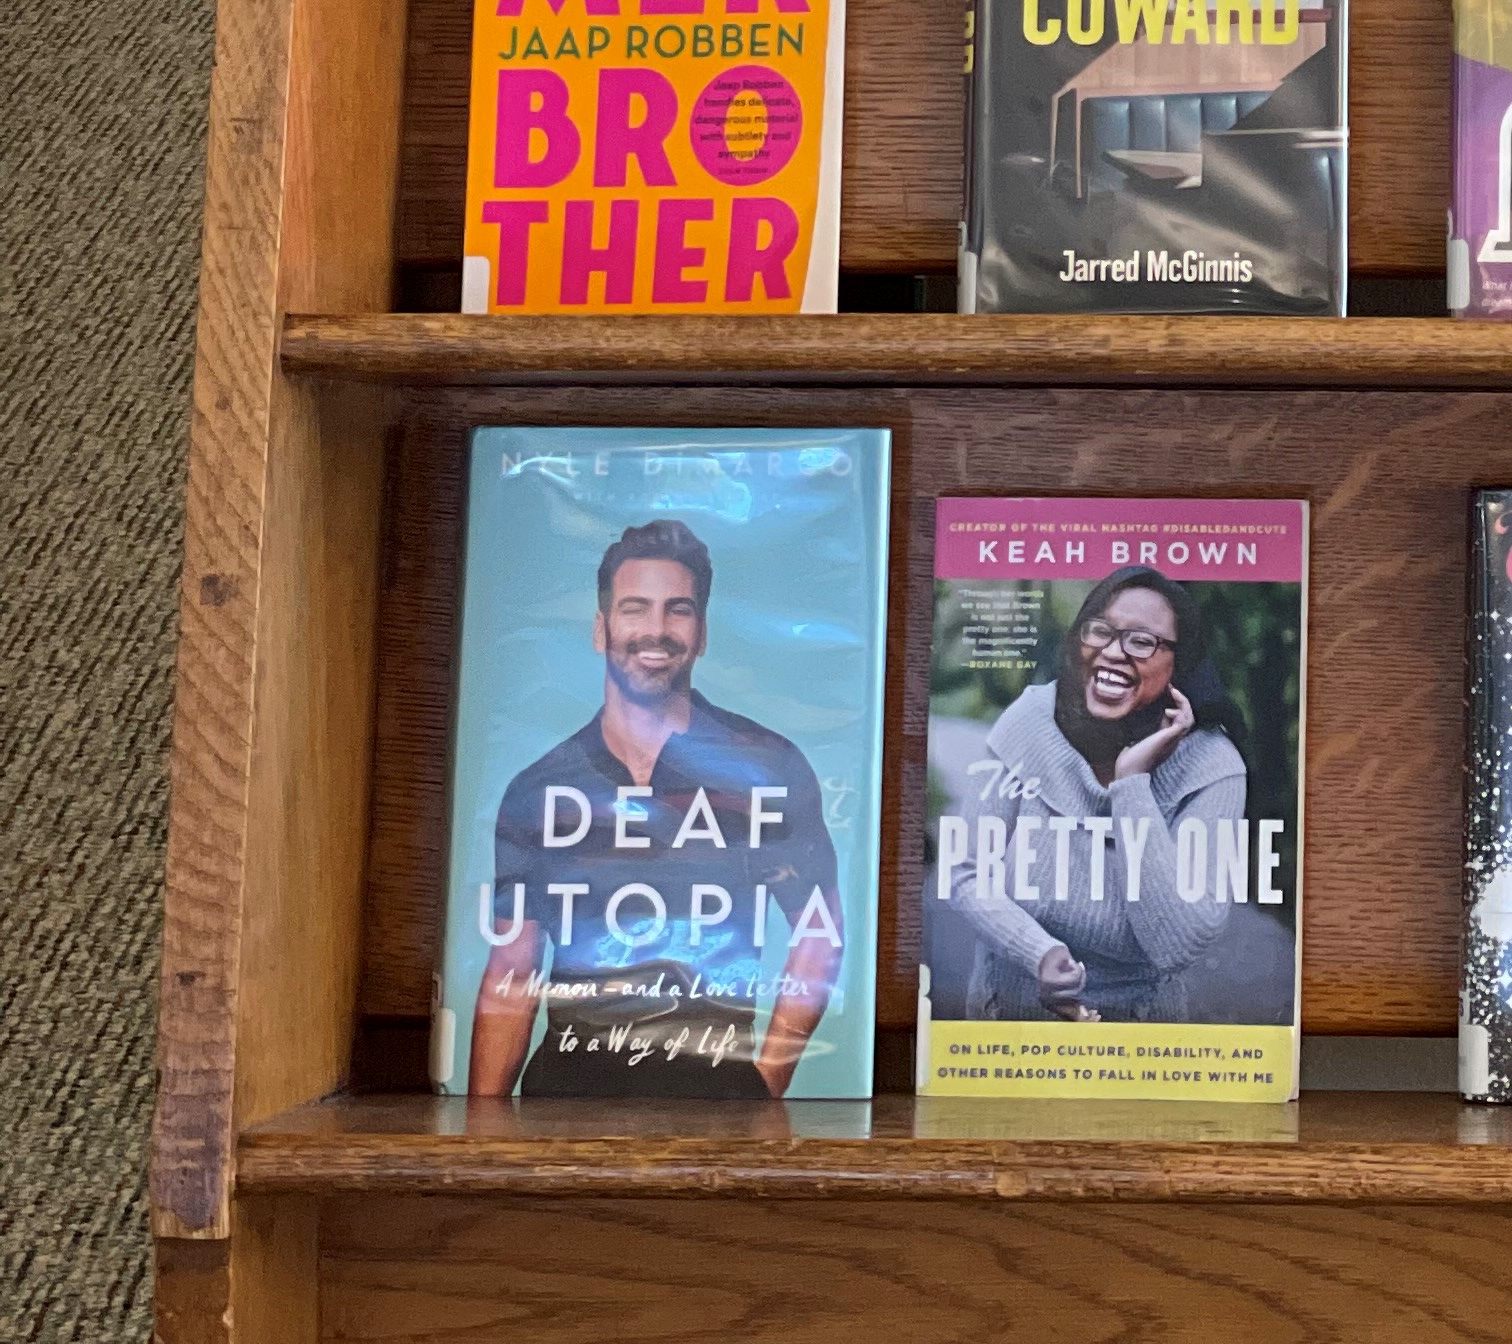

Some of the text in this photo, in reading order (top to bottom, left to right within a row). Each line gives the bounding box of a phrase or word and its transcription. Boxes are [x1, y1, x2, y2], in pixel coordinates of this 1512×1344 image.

[498, 22, 804, 60] JAAP ROBBEN
[493, 65, 802, 189] BRO
[482, 197, 799, 306] THER
[1060, 250, 1253, 282] Jarred McGinnis
[979, 541, 1257, 565] KEAH BROWN
[968, 759, 1041, 801] The
[544, 787, 788, 849] DEAF
[938, 816, 1284, 905] PRETTY ONE
[479, 883, 843, 948] UTOPIA
[495, 970, 513, 1000] A
[521, 970, 597, 998] Memoir
[670, 983, 682, 997] a
[690, 973, 736, 999] Love
[559, 1022, 739, 1067] to a Way of Life
[950, 1044, 1263, 1060] ON LIFE, POP CULTURE, DISABILITY, AND
[938, 1067, 1273, 1083] OTHER REASONS TO FALL IN LOVE WITH ME
